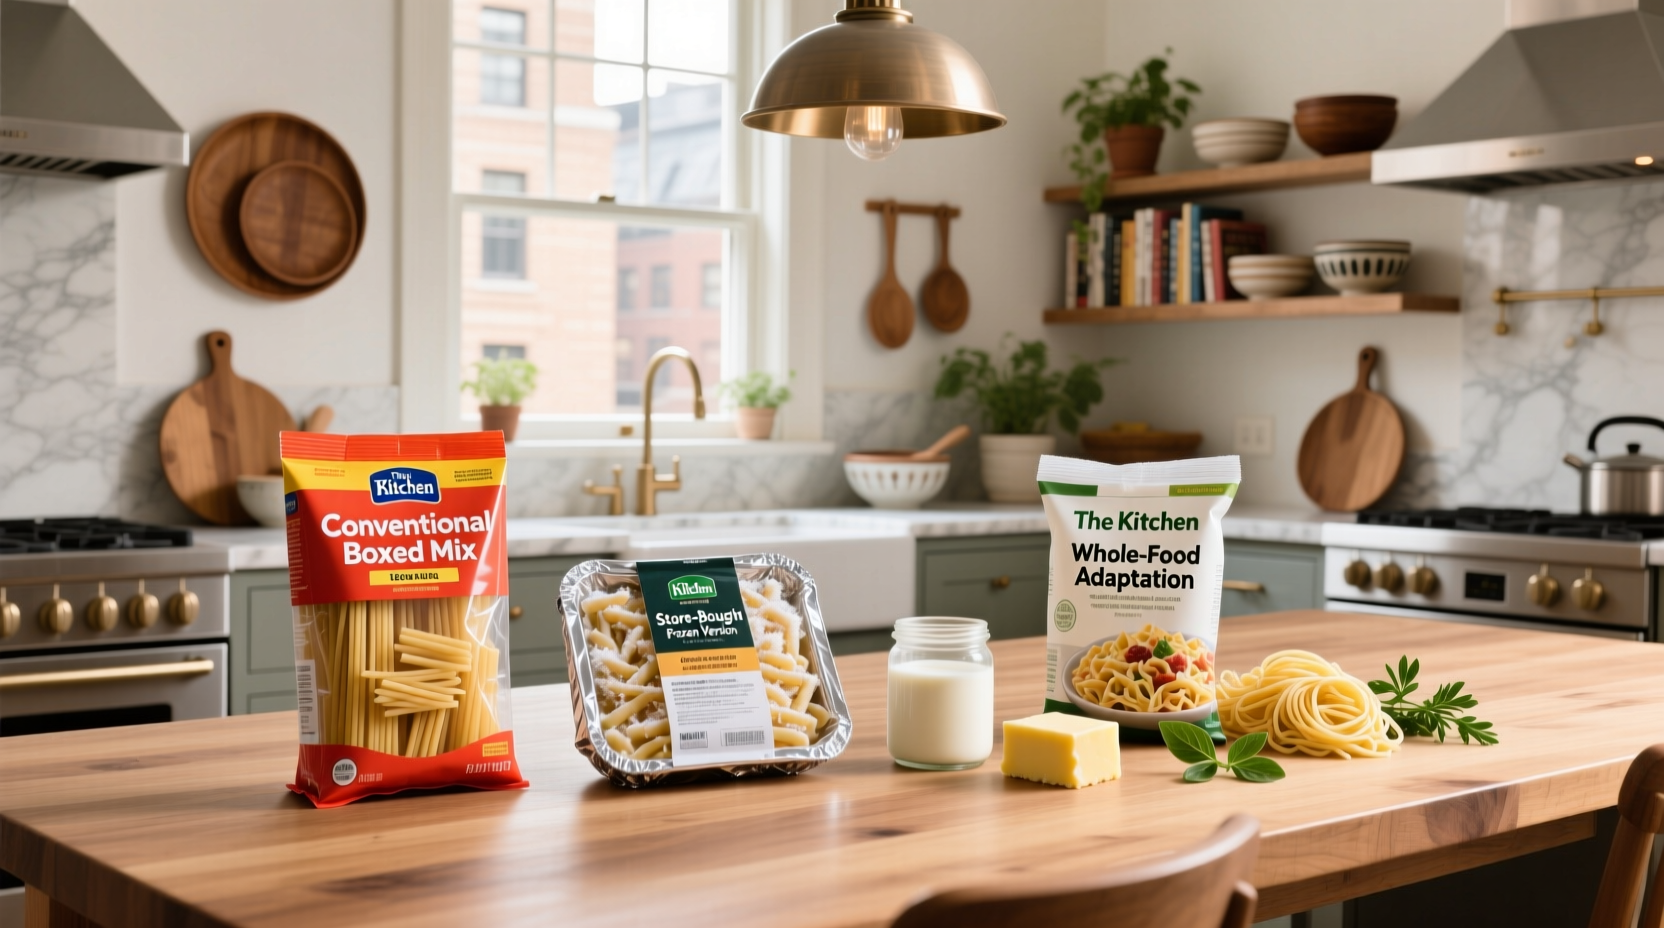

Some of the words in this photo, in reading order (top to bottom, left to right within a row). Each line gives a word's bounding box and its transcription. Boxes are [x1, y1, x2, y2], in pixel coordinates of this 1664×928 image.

[374, 475, 434, 496] Kitchen
[321, 510, 491, 538] Conventional
[1074, 510, 1113, 531] The
[1118, 511, 1199, 531] Kitchen
[343, 540, 424, 565] Boxed
[430, 539, 478, 562] Mix
[1071, 543, 1201, 565] Whole-Food
[1074, 566, 1194, 593] Adaptation
